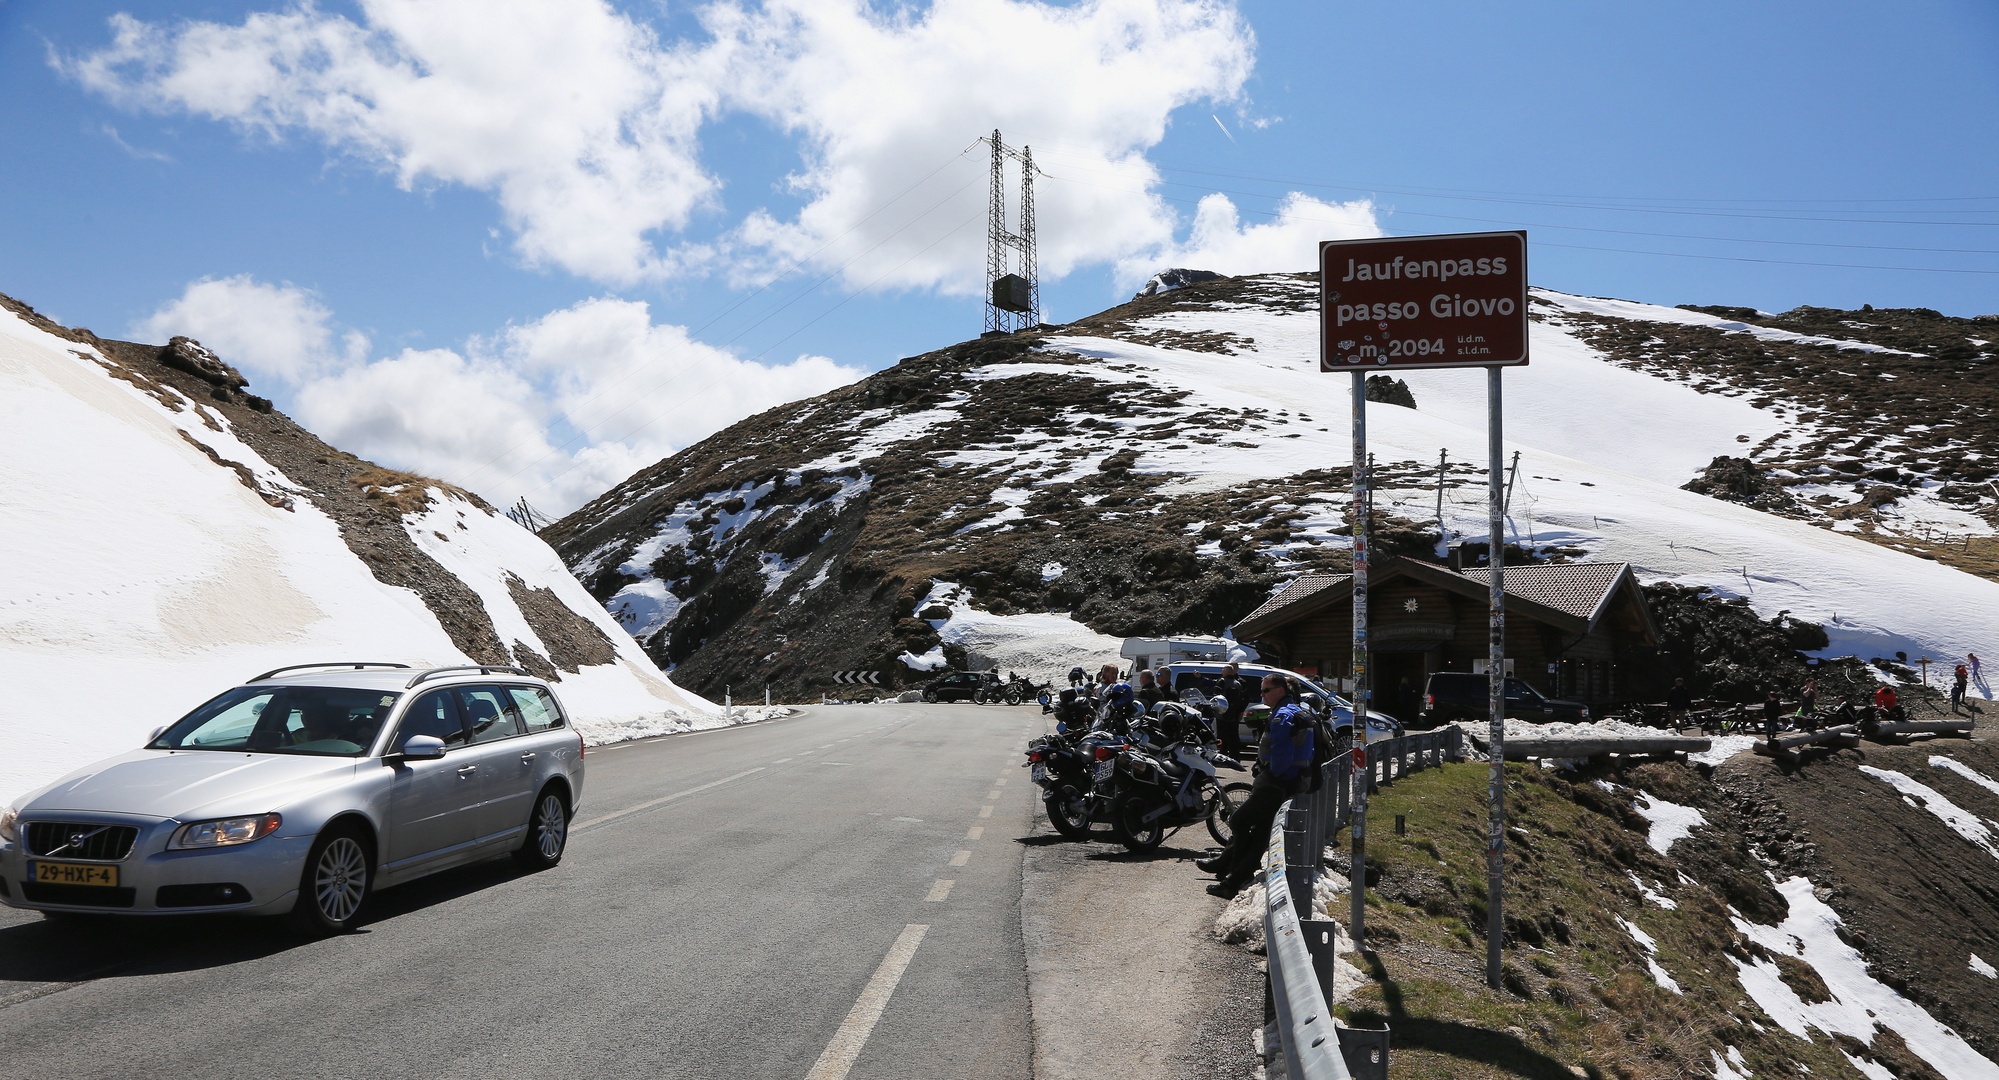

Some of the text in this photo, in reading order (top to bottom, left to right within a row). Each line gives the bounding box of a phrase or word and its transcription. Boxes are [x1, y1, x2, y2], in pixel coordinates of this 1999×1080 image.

[1342, 256, 1507, 282] Jaufenpass
[1337, 293, 1515, 326] passo Giovo
[1388, 338, 1445, 356] 2094
[1457, 334, 1486, 343] ü.d.m.
[1457, 346, 1491, 355] s.l.d.m.
[40, 865, 110, 883] 29-HXF-4
